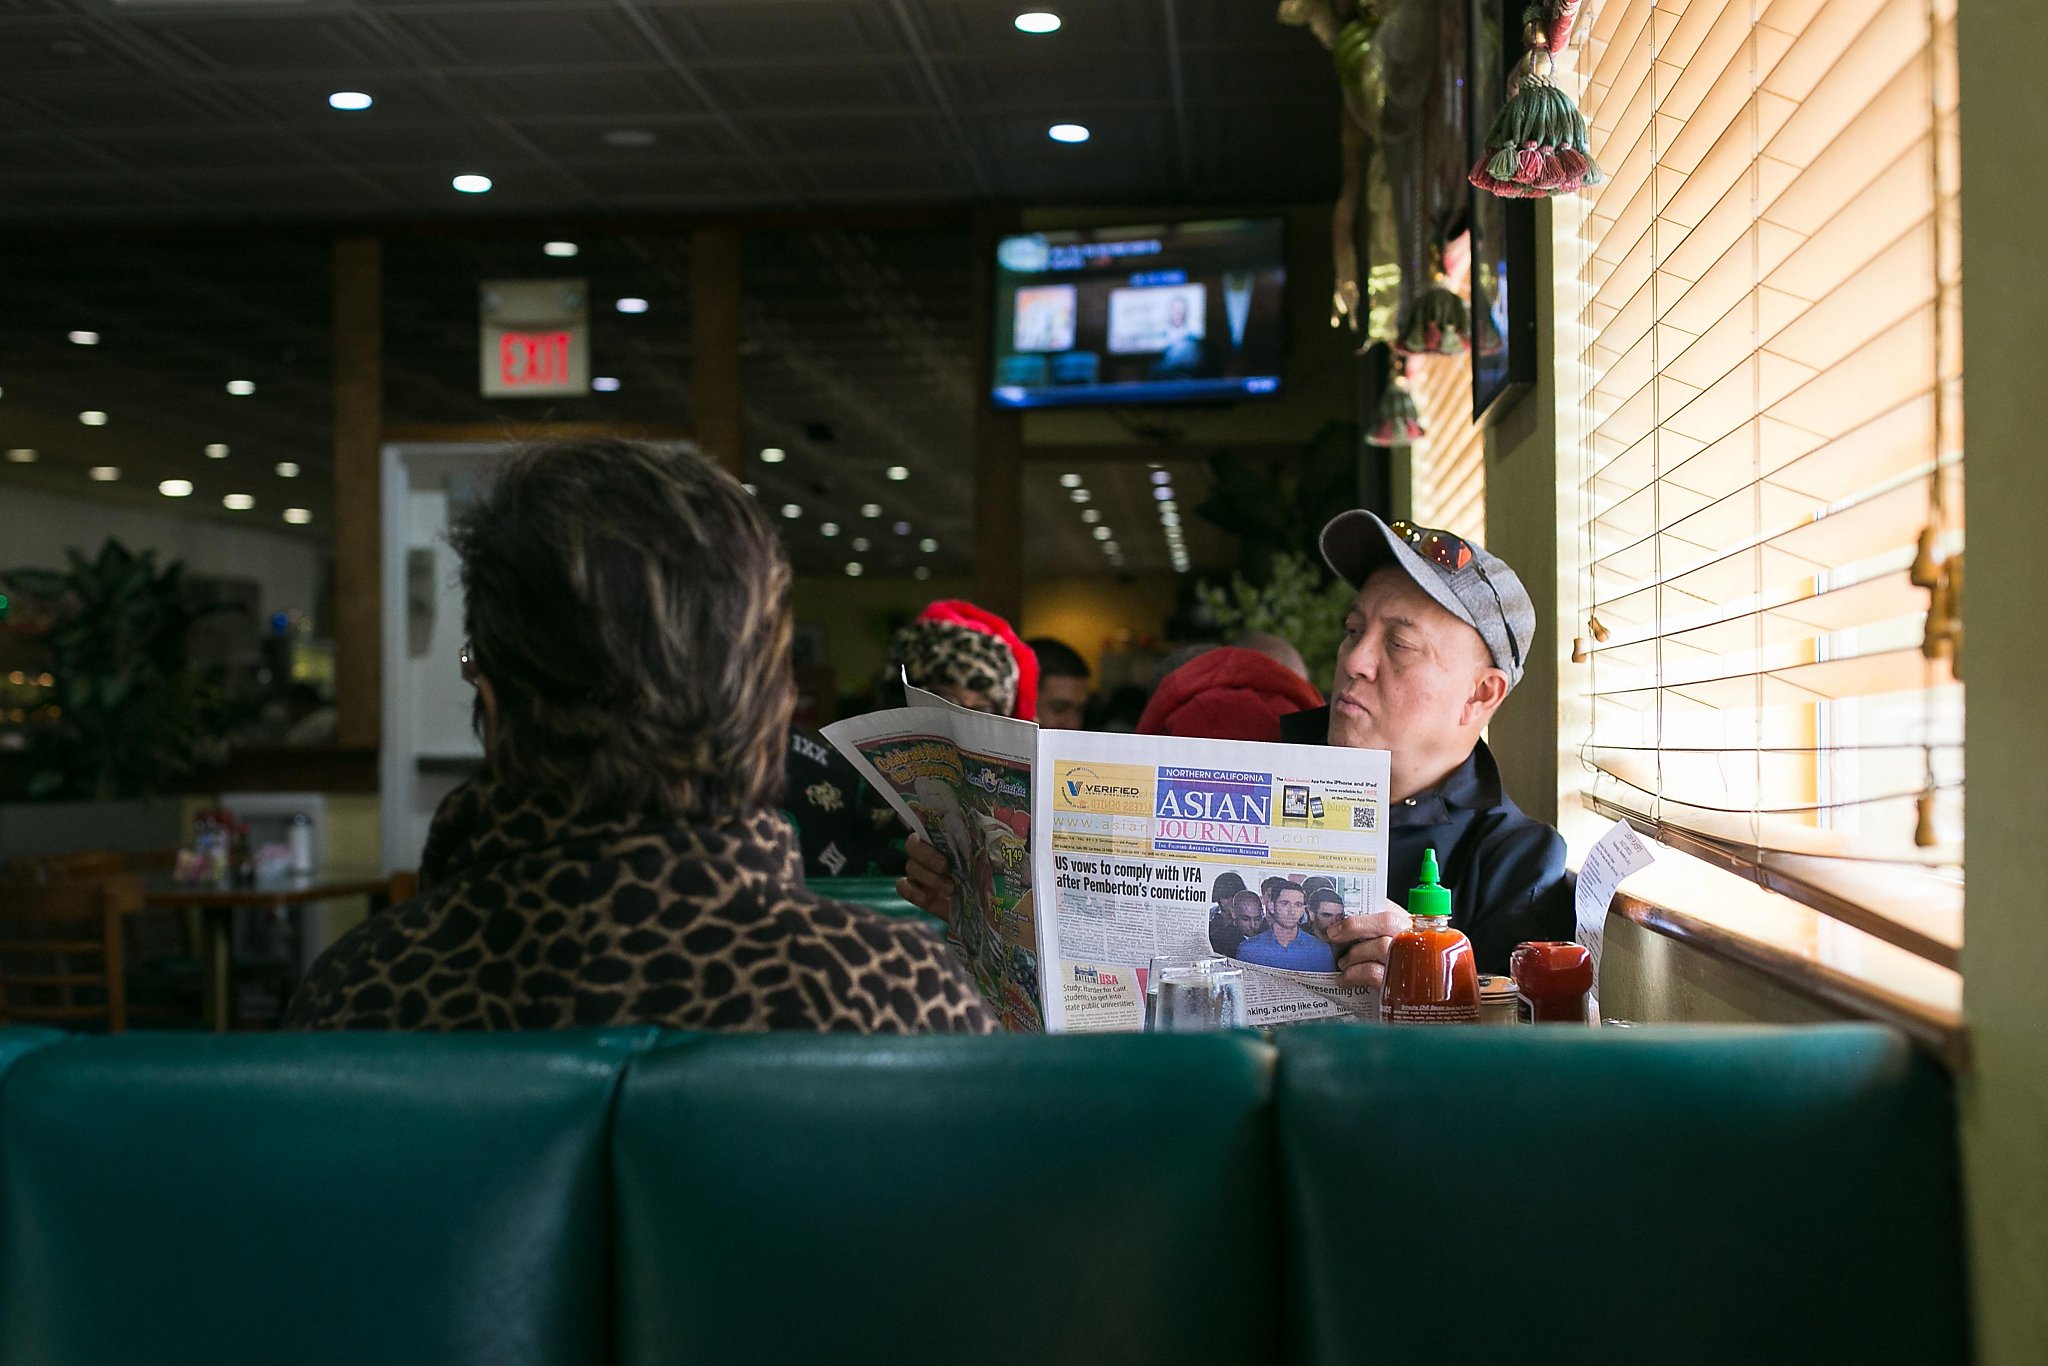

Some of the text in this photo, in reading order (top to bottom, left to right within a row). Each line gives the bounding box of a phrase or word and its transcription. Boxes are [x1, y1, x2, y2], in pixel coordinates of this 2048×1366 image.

[501, 332, 569, 385] EXIT
[1166, 769, 1264, 782] NORTHERN CALIFORNIA
[998, 778, 1026, 796] Pacific
[1085, 785, 1139, 795] VERIFIED
[1156, 789, 1270, 823] ASIAN
[1156, 820, 1267, 844] JOURNAL
[1189, 844, 1210, 852] AMERICAN
[1055, 855, 1202, 883] US vows to comply with VFA
[1056, 874, 1081, 890] after
[1083, 876, 1147, 897] Pemberton's
[1150, 883, 1207, 902] conviction
[1099, 973, 1119, 985] USA
[1083, 985, 1102, 993] Harder
[1064, 994, 1089, 1002] students
[1065, 1003, 1080, 1012] state
[1081, 1001, 1100, 1012] public
[1272, 1002, 1297, 1014] acting
[1298, 1001, 1312, 1010] like
[1313, 1001, 1328, 1009] God
